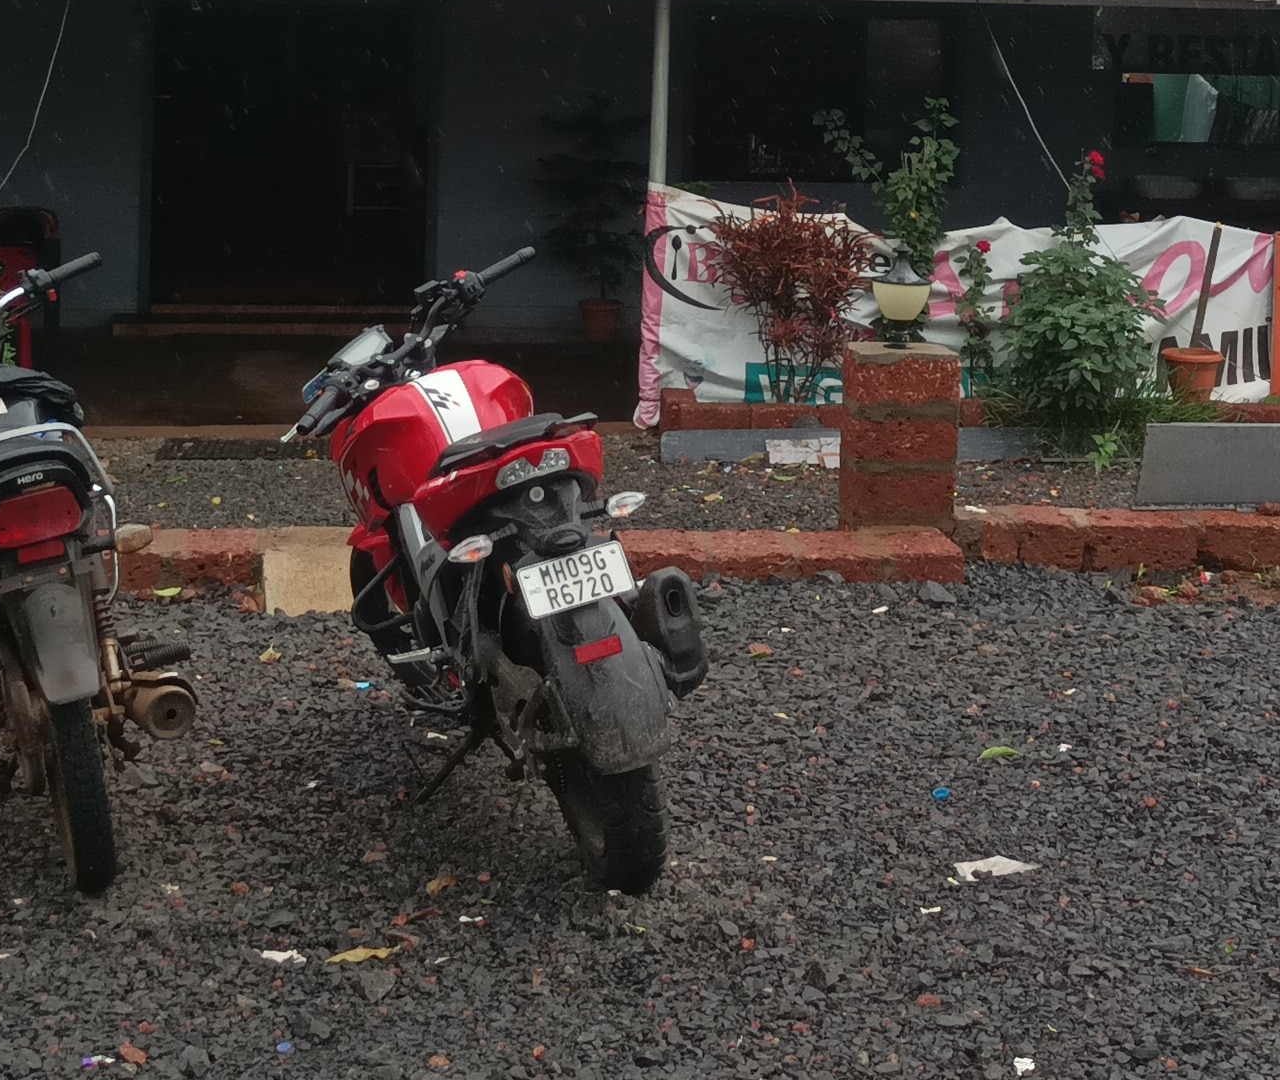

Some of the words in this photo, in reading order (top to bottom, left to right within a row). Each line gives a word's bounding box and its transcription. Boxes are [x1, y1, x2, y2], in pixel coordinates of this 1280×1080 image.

[17, 471, 44, 485] Hero
[538, 549, 607, 586] MH09G
[546, 572, 614, 610] R6720
